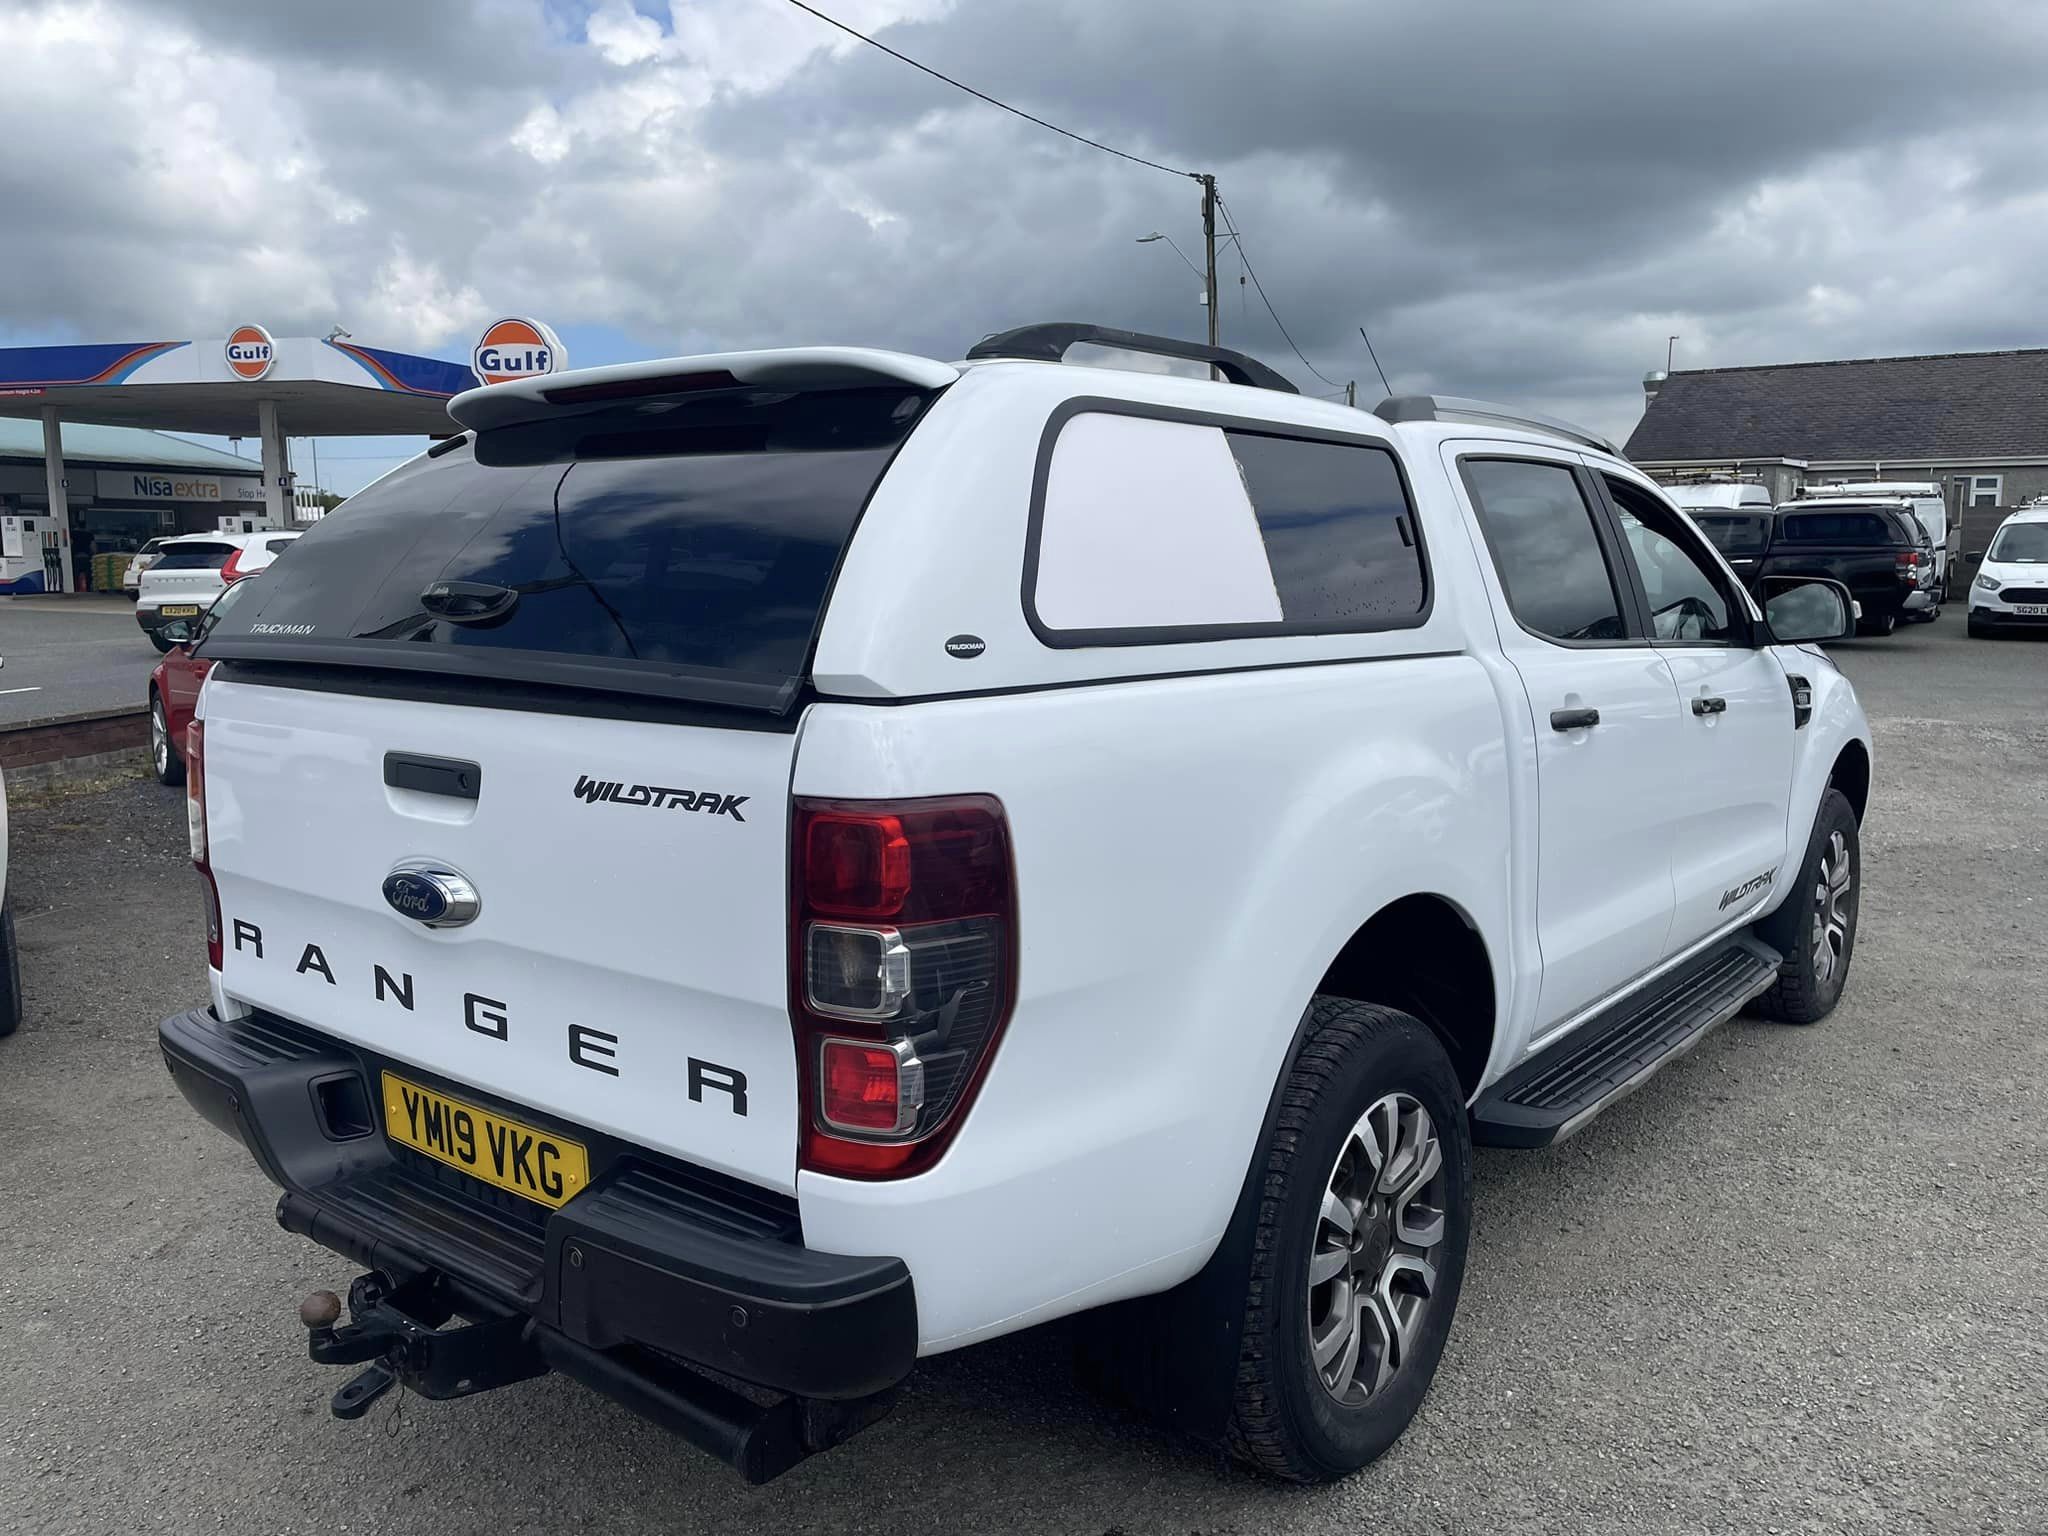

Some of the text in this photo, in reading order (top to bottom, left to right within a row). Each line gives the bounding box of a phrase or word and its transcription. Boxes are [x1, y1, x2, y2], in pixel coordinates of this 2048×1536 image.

[228, 345, 269, 359] Gulf
[479, 349, 548, 371] Gulf
[133, 475, 219, 498] Nisa extra
[249, 624, 316, 635] TRUCKMAN
[947, 643, 985, 651] TRUCKMAN
[573, 774, 752, 823] WILDTRAK
[392, 879, 430, 912] Ford
[1718, 865, 1778, 911] WILDTRAK
[232, 917, 750, 1117] RANGER
[401, 1086, 565, 1199] YM19 VKG
